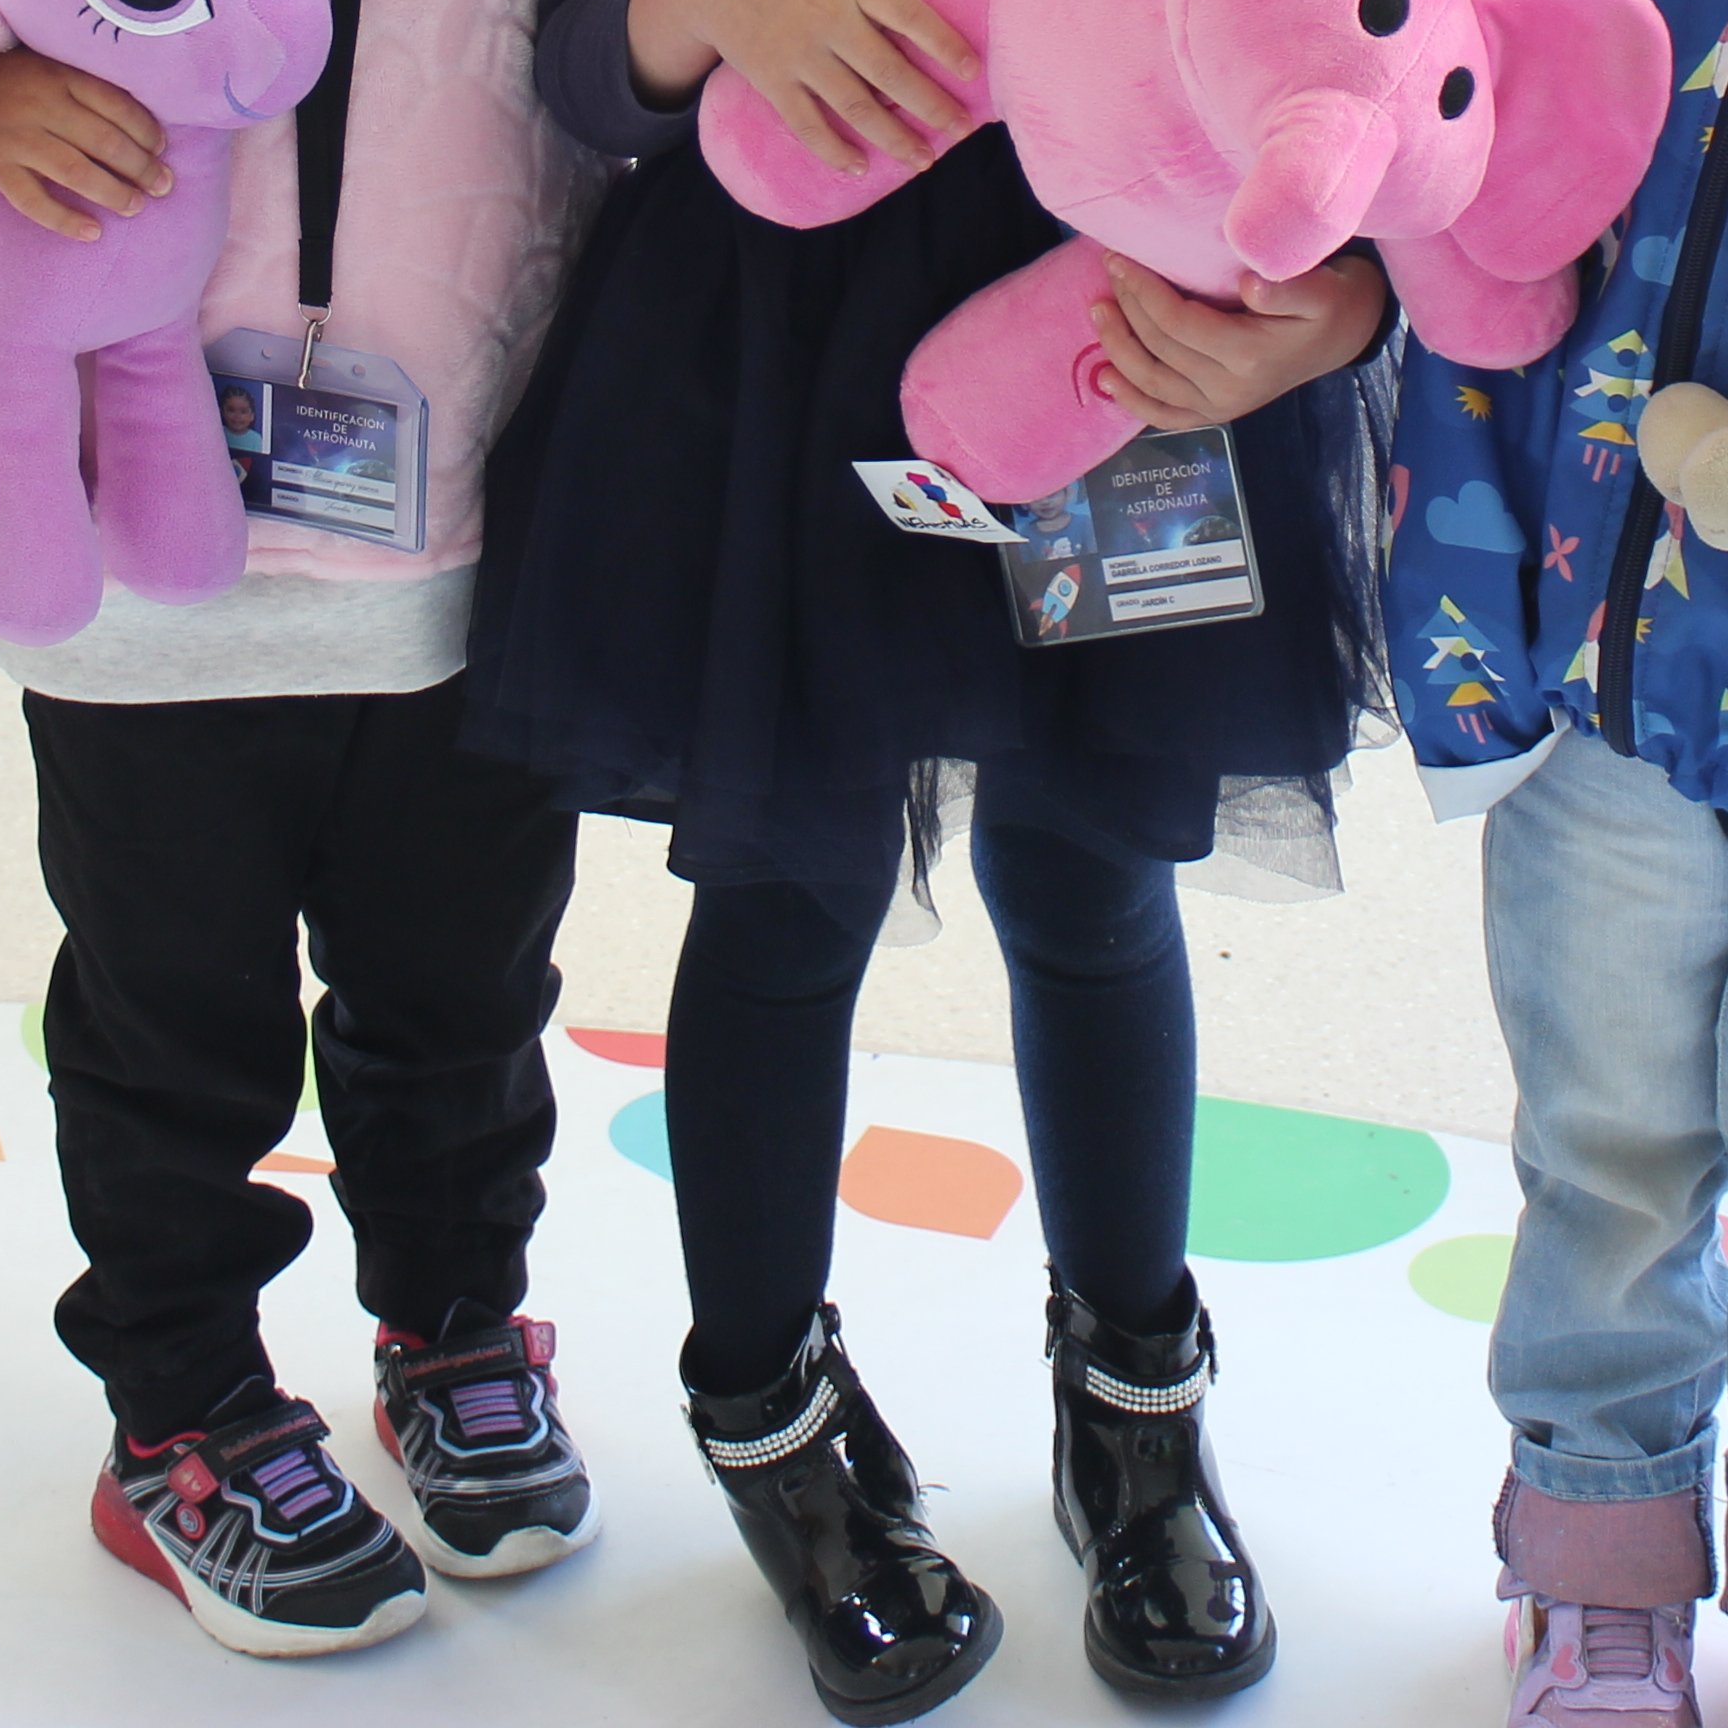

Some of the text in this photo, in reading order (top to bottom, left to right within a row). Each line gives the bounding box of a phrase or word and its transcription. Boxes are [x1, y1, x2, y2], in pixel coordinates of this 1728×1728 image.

[296, 405, 385, 431] IDENTIFICACION
[332, 423, 348, 434] DE
[303, 428, 377, 452] ASTRONAUTA
[1112, 462, 1212, 488] IDENTIFICACION
[1154, 482, 1174, 497] DE
[1126, 493, 1209, 515] ASTRONAUTA
